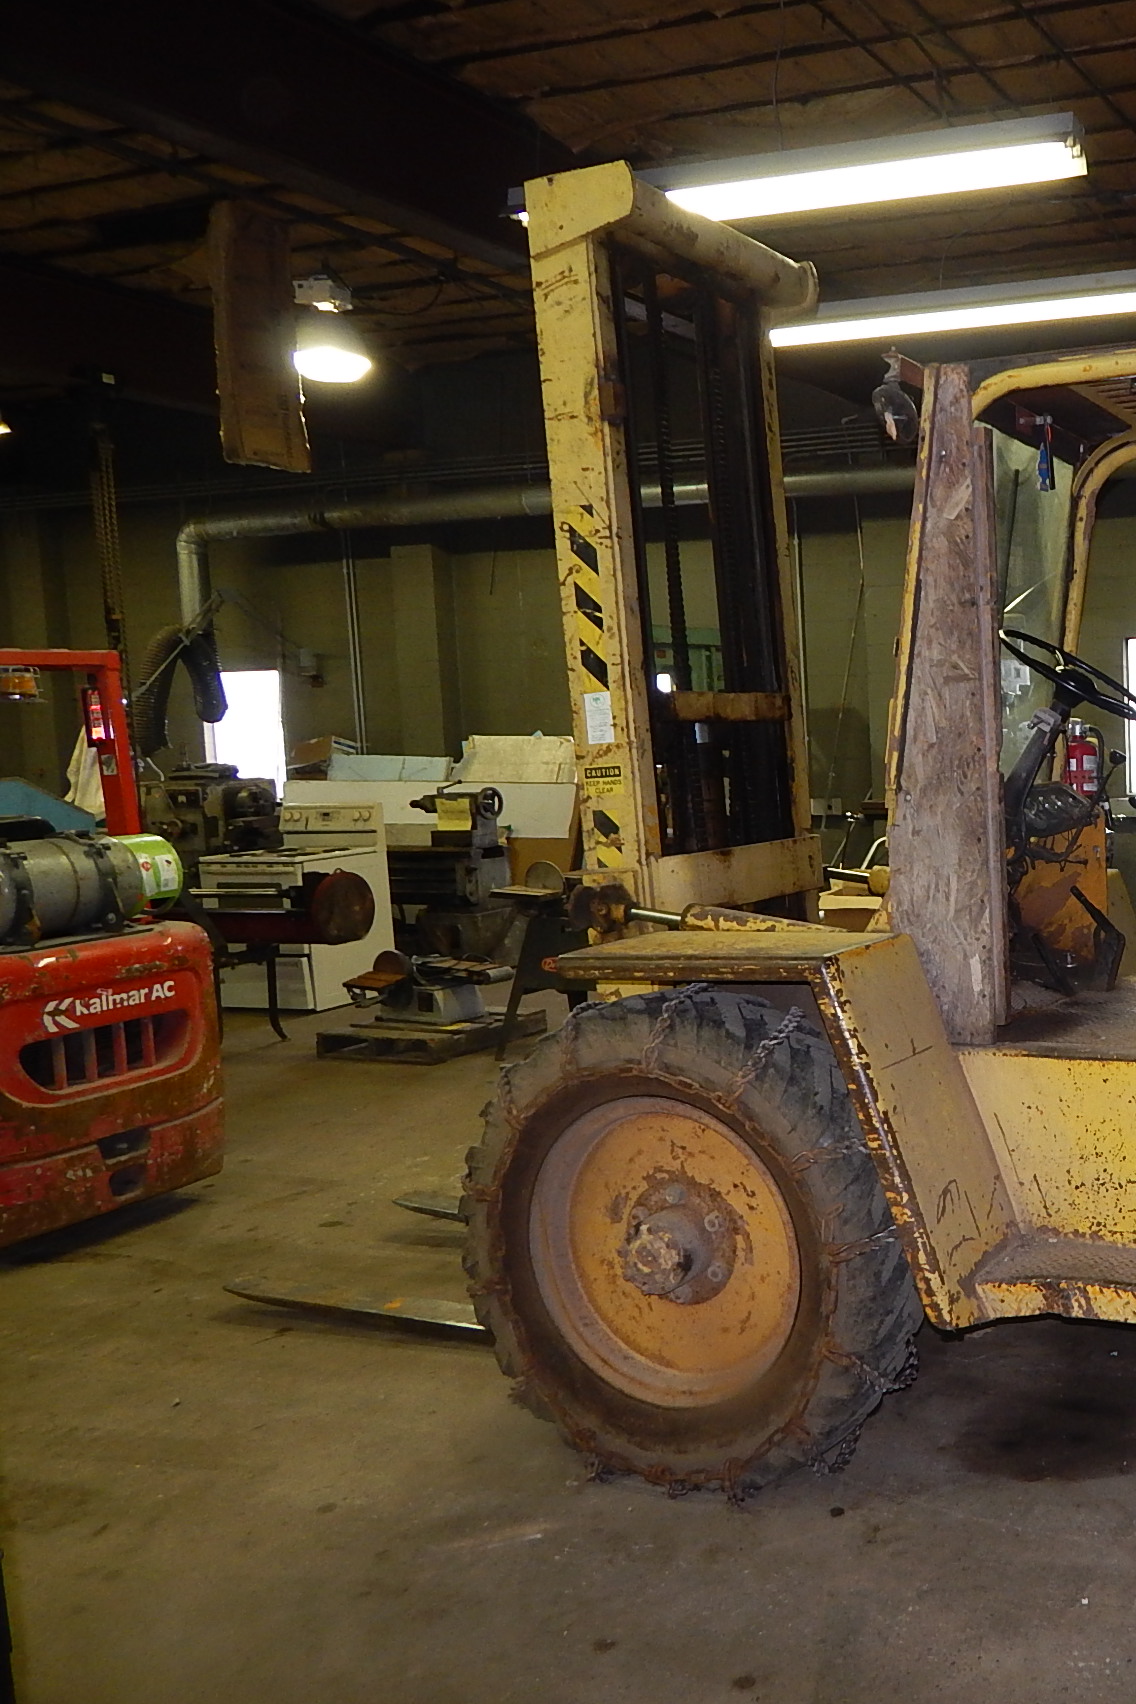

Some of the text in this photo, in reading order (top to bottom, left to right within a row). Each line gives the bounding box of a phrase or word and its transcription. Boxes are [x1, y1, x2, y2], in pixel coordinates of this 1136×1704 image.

[586, 768, 620, 777] CAUTION
[602, 778, 622, 786] HANDS
[75, 987, 149, 1016] Kalmar
[151, 980, 175, 1001] AC
